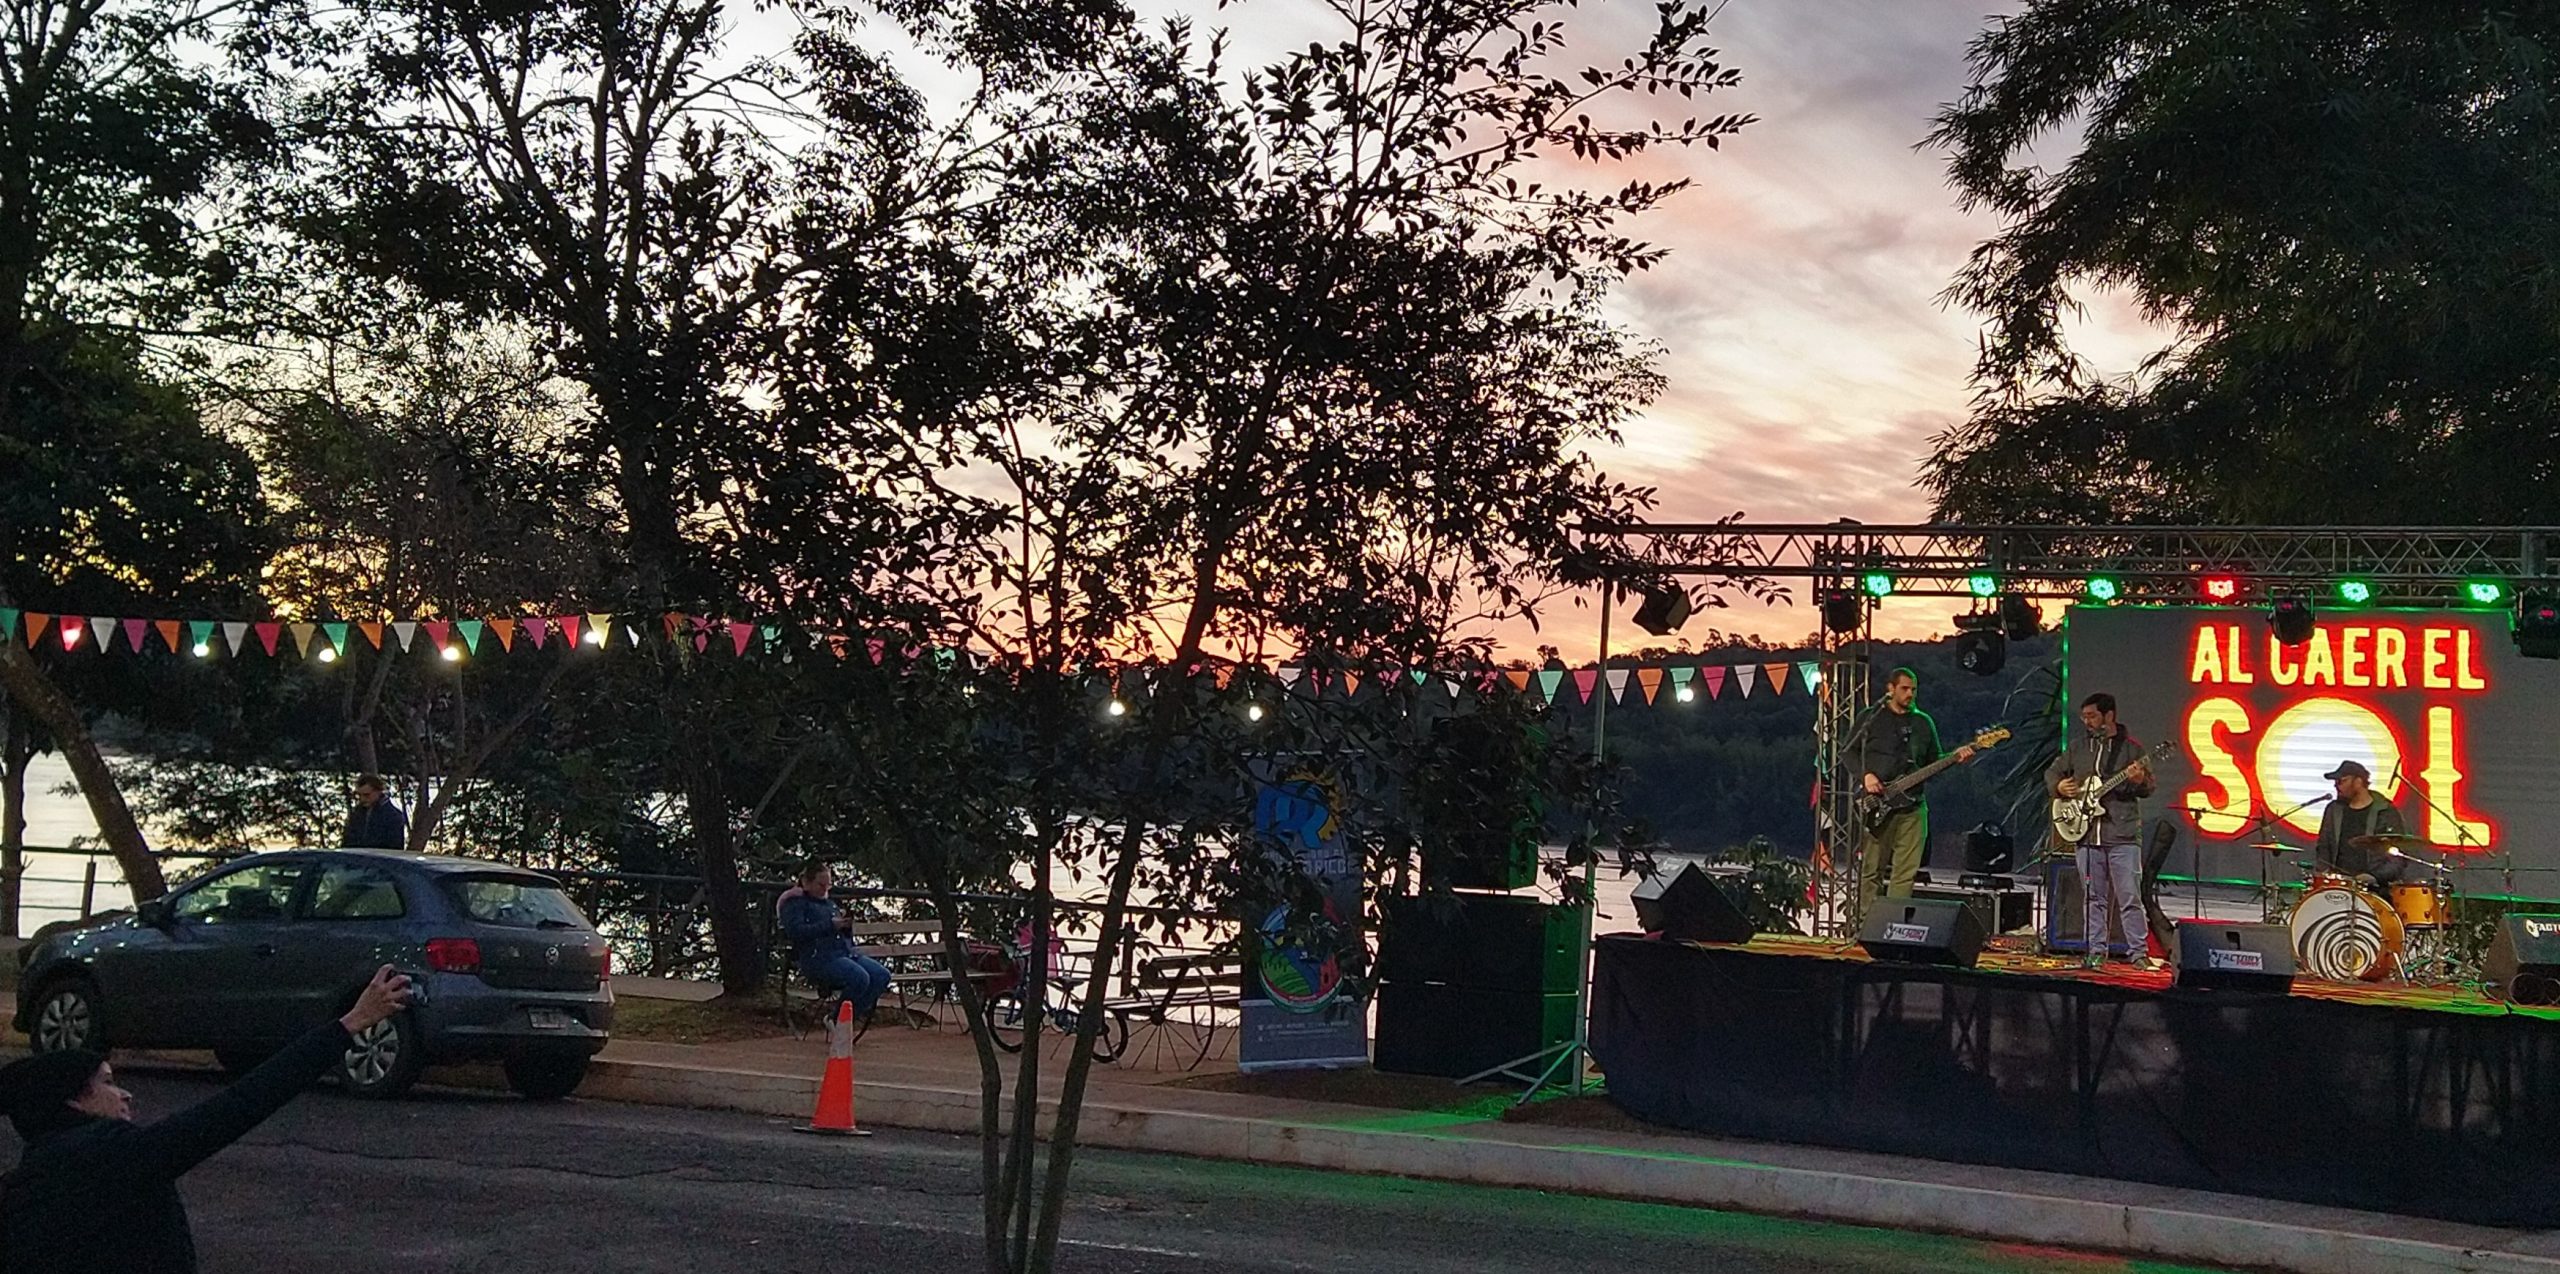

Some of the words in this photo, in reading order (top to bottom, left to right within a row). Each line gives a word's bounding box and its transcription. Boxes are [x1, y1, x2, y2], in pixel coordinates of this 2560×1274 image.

[2191, 626, 2254, 684] AL
[2270, 627, 2408, 688] CAER
[2423, 628, 2486, 690] EL
[2186, 696, 2491, 847] SOL
